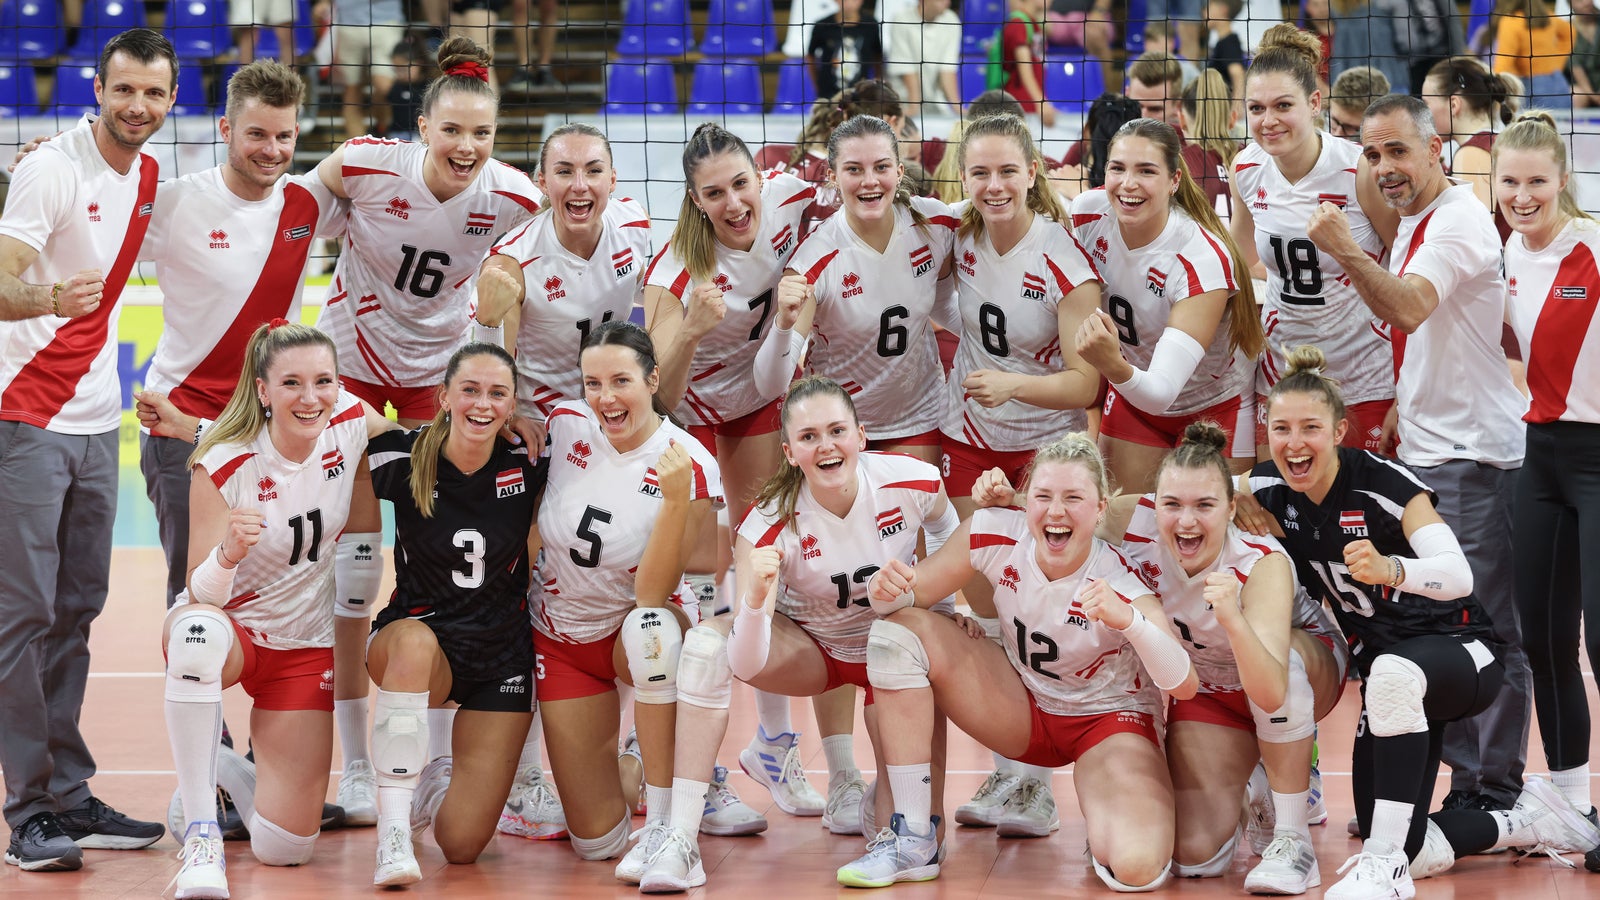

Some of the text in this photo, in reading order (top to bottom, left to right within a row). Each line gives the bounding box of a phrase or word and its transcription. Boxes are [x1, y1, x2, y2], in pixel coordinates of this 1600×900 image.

[385, 207, 409, 221] errea
[466, 226, 491, 236] AUT
[777, 236, 792, 257] AUT
[393, 243, 452, 298] 16
[615, 261, 633, 278] AUT
[915, 260, 932, 277] AUT
[1269, 235, 1321, 295] 18
[842, 286, 863, 299] errea
[1023, 289, 1046, 301] AUT
[748, 288, 773, 341] 7
[1109, 294, 1139, 346] 9
[576, 309, 615, 349] 1
[876, 303, 910, 357] 6
[979, 302, 1010, 357] 8
[1104, 391, 1116, 416] 9
[567, 452, 588, 469] errea
[258, 490, 278, 502] errea
[500, 483, 523, 496] AUT
[641, 483, 661, 496] AU
[288, 508, 323, 565] 11
[569, 504, 613, 567] 5
[880, 521, 904, 537] AUT
[451, 528, 486, 589] 3
[803, 548, 821, 561] rrea
[1309, 560, 1375, 618] 15
[641, 620, 662, 629] errea
[185, 636, 206, 644] errea
[1013, 615, 1063, 681] 12
[535, 653, 546, 680] 5
[500, 683, 525, 694] errea
[1117, 716, 1146, 727] errea
